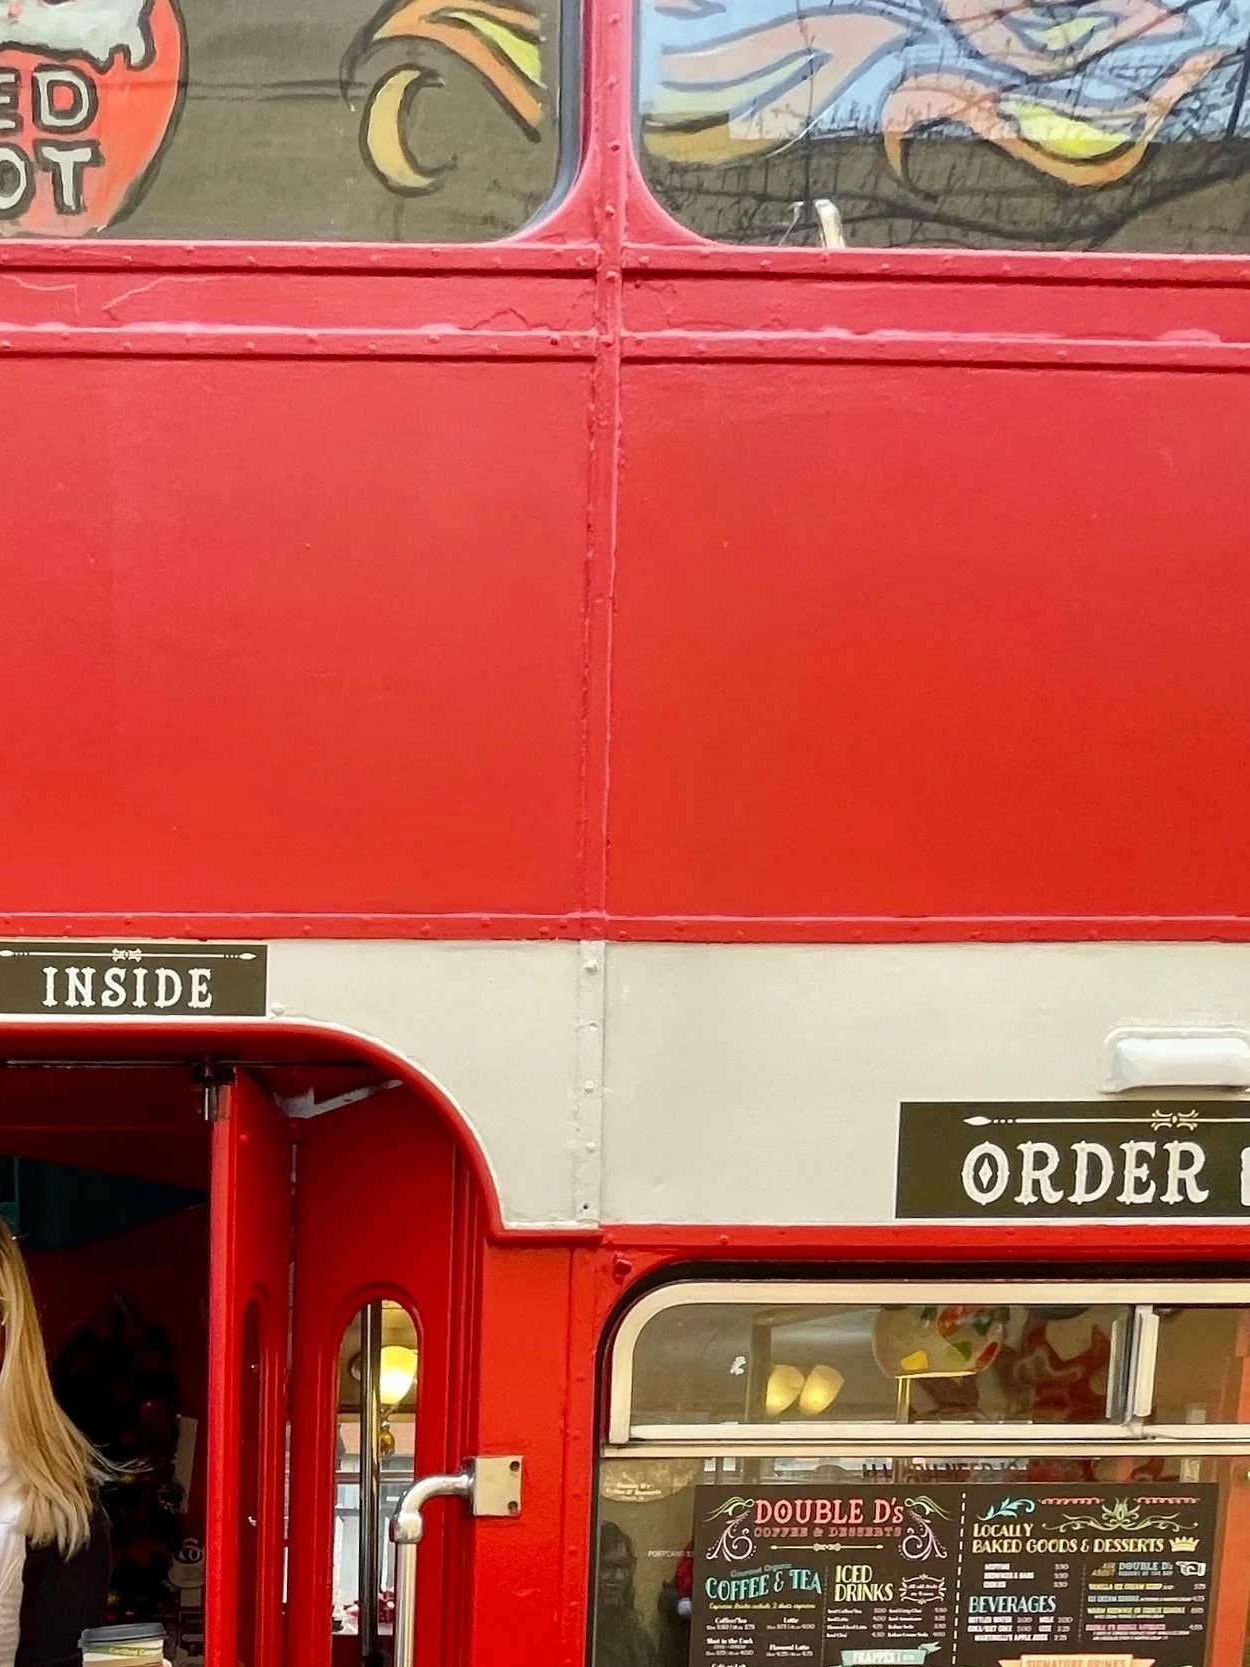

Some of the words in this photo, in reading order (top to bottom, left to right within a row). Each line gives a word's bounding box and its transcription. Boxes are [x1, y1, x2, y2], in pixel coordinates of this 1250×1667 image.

[42, 967, 213, 1009] INSIDE
[961, 1140, 1210, 1206] ORDER
[754, 1499, 863, 1524] DOUBLE
[873, 1497, 904, 1524] D's
[754, 1527, 808, 1538] COFFEE
[813, 1527, 824, 1537] &
[829, 1527, 902, 1537] DESSERTS
[973, 1523, 1034, 1537] LOCALLY
[972, 1539, 1022, 1553] BAKED
[1026, 1539, 1078, 1553] GOODS
[1080, 1539, 1089, 1553] &
[1093, 1538, 1164, 1553] DESSERTS
[835, 1565, 872, 1583] ICED
[1118, 1562, 1159, 1570] DOUBLE
[705, 1574, 770, 1601] COFFEE
[773, 1571, 784, 1592] &
[789, 1569, 823, 1595] TEA
[834, 1583, 893, 1601] DRINKS
[968, 1595, 1057, 1613] BEVERAGES
